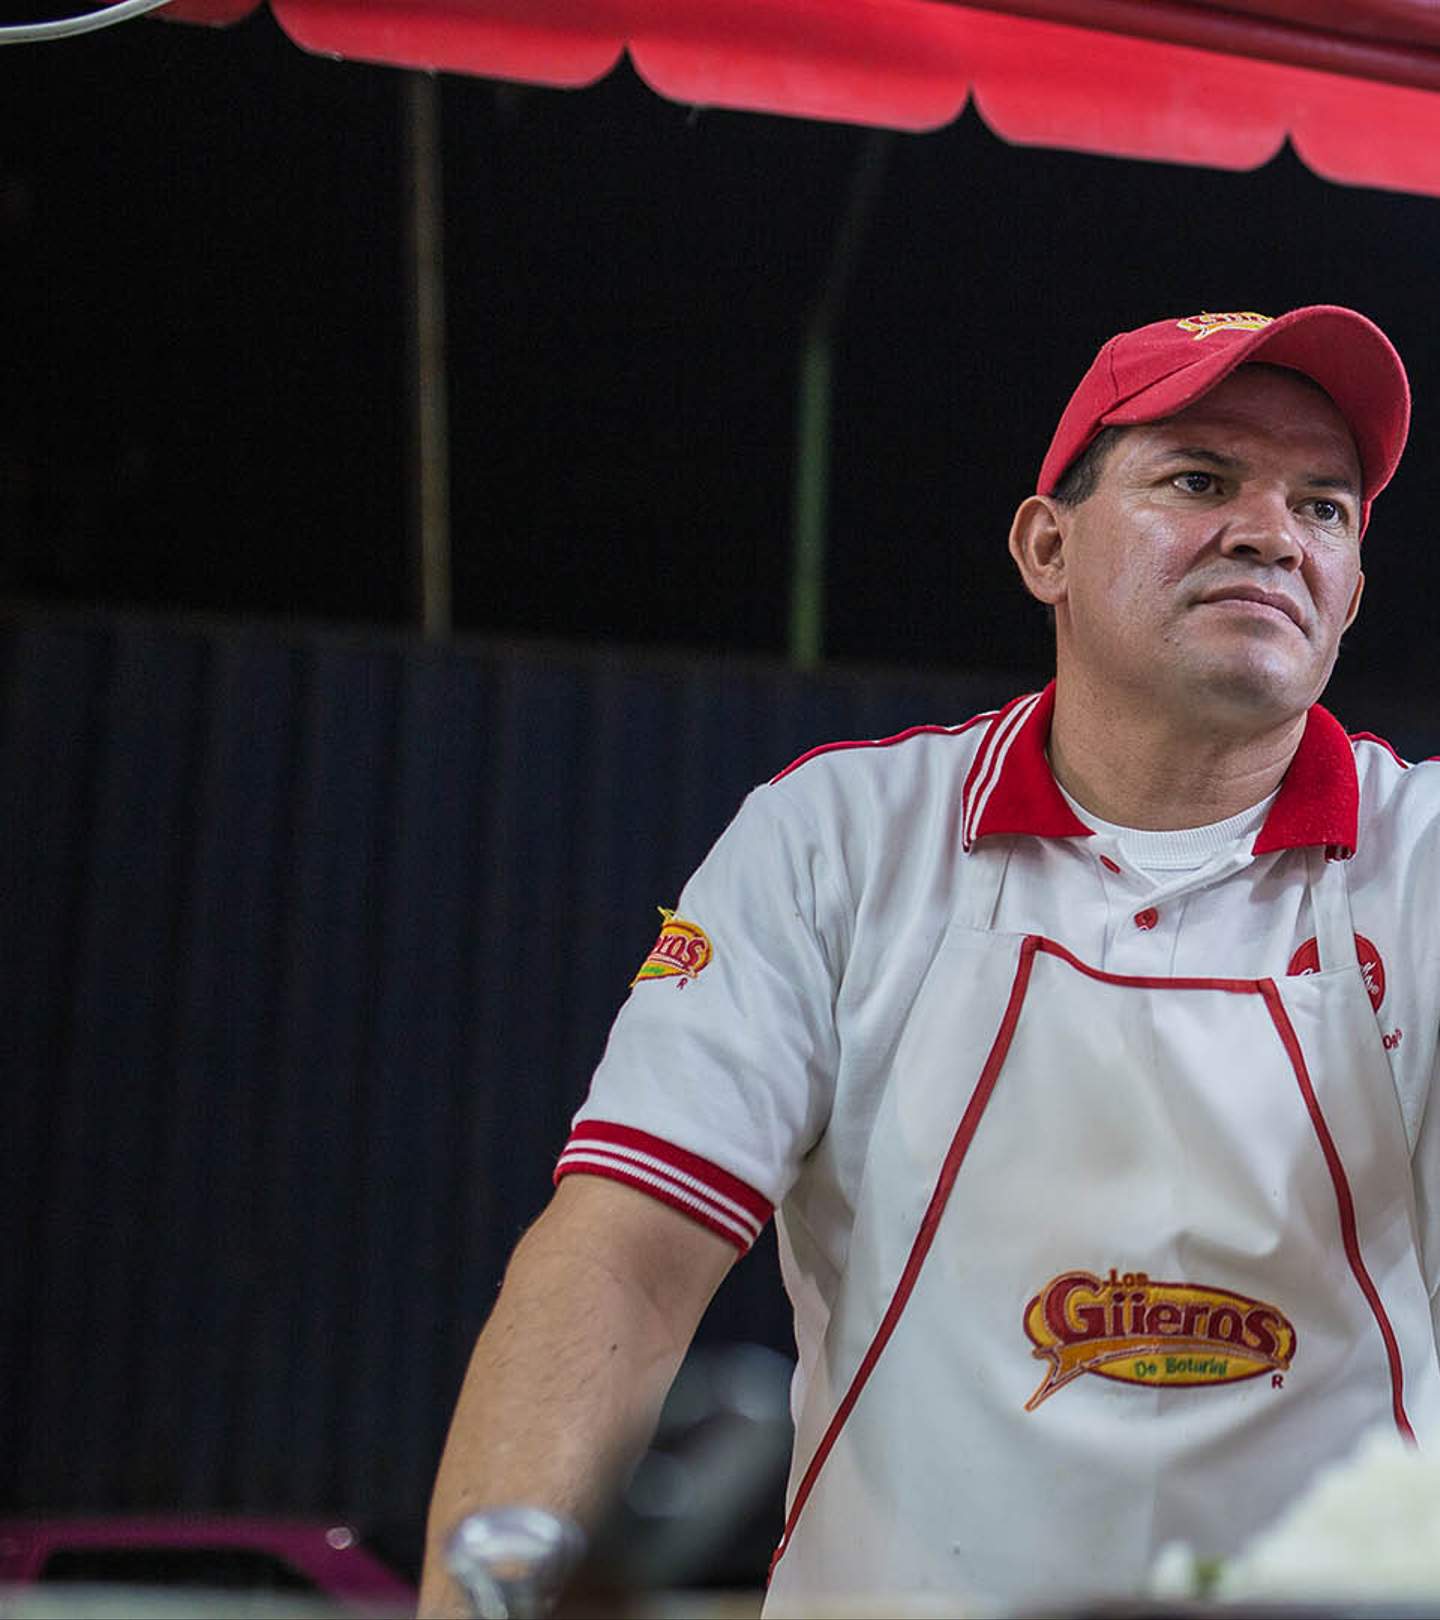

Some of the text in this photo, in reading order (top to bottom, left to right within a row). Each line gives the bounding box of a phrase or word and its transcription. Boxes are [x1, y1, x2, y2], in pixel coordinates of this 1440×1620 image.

[1109, 1269, 1148, 1287] Los
[1045, 1276, 1280, 1355] Güeros
[1136, 1361, 1157, 1376] De
[1271, 1374, 1283, 1388] R
